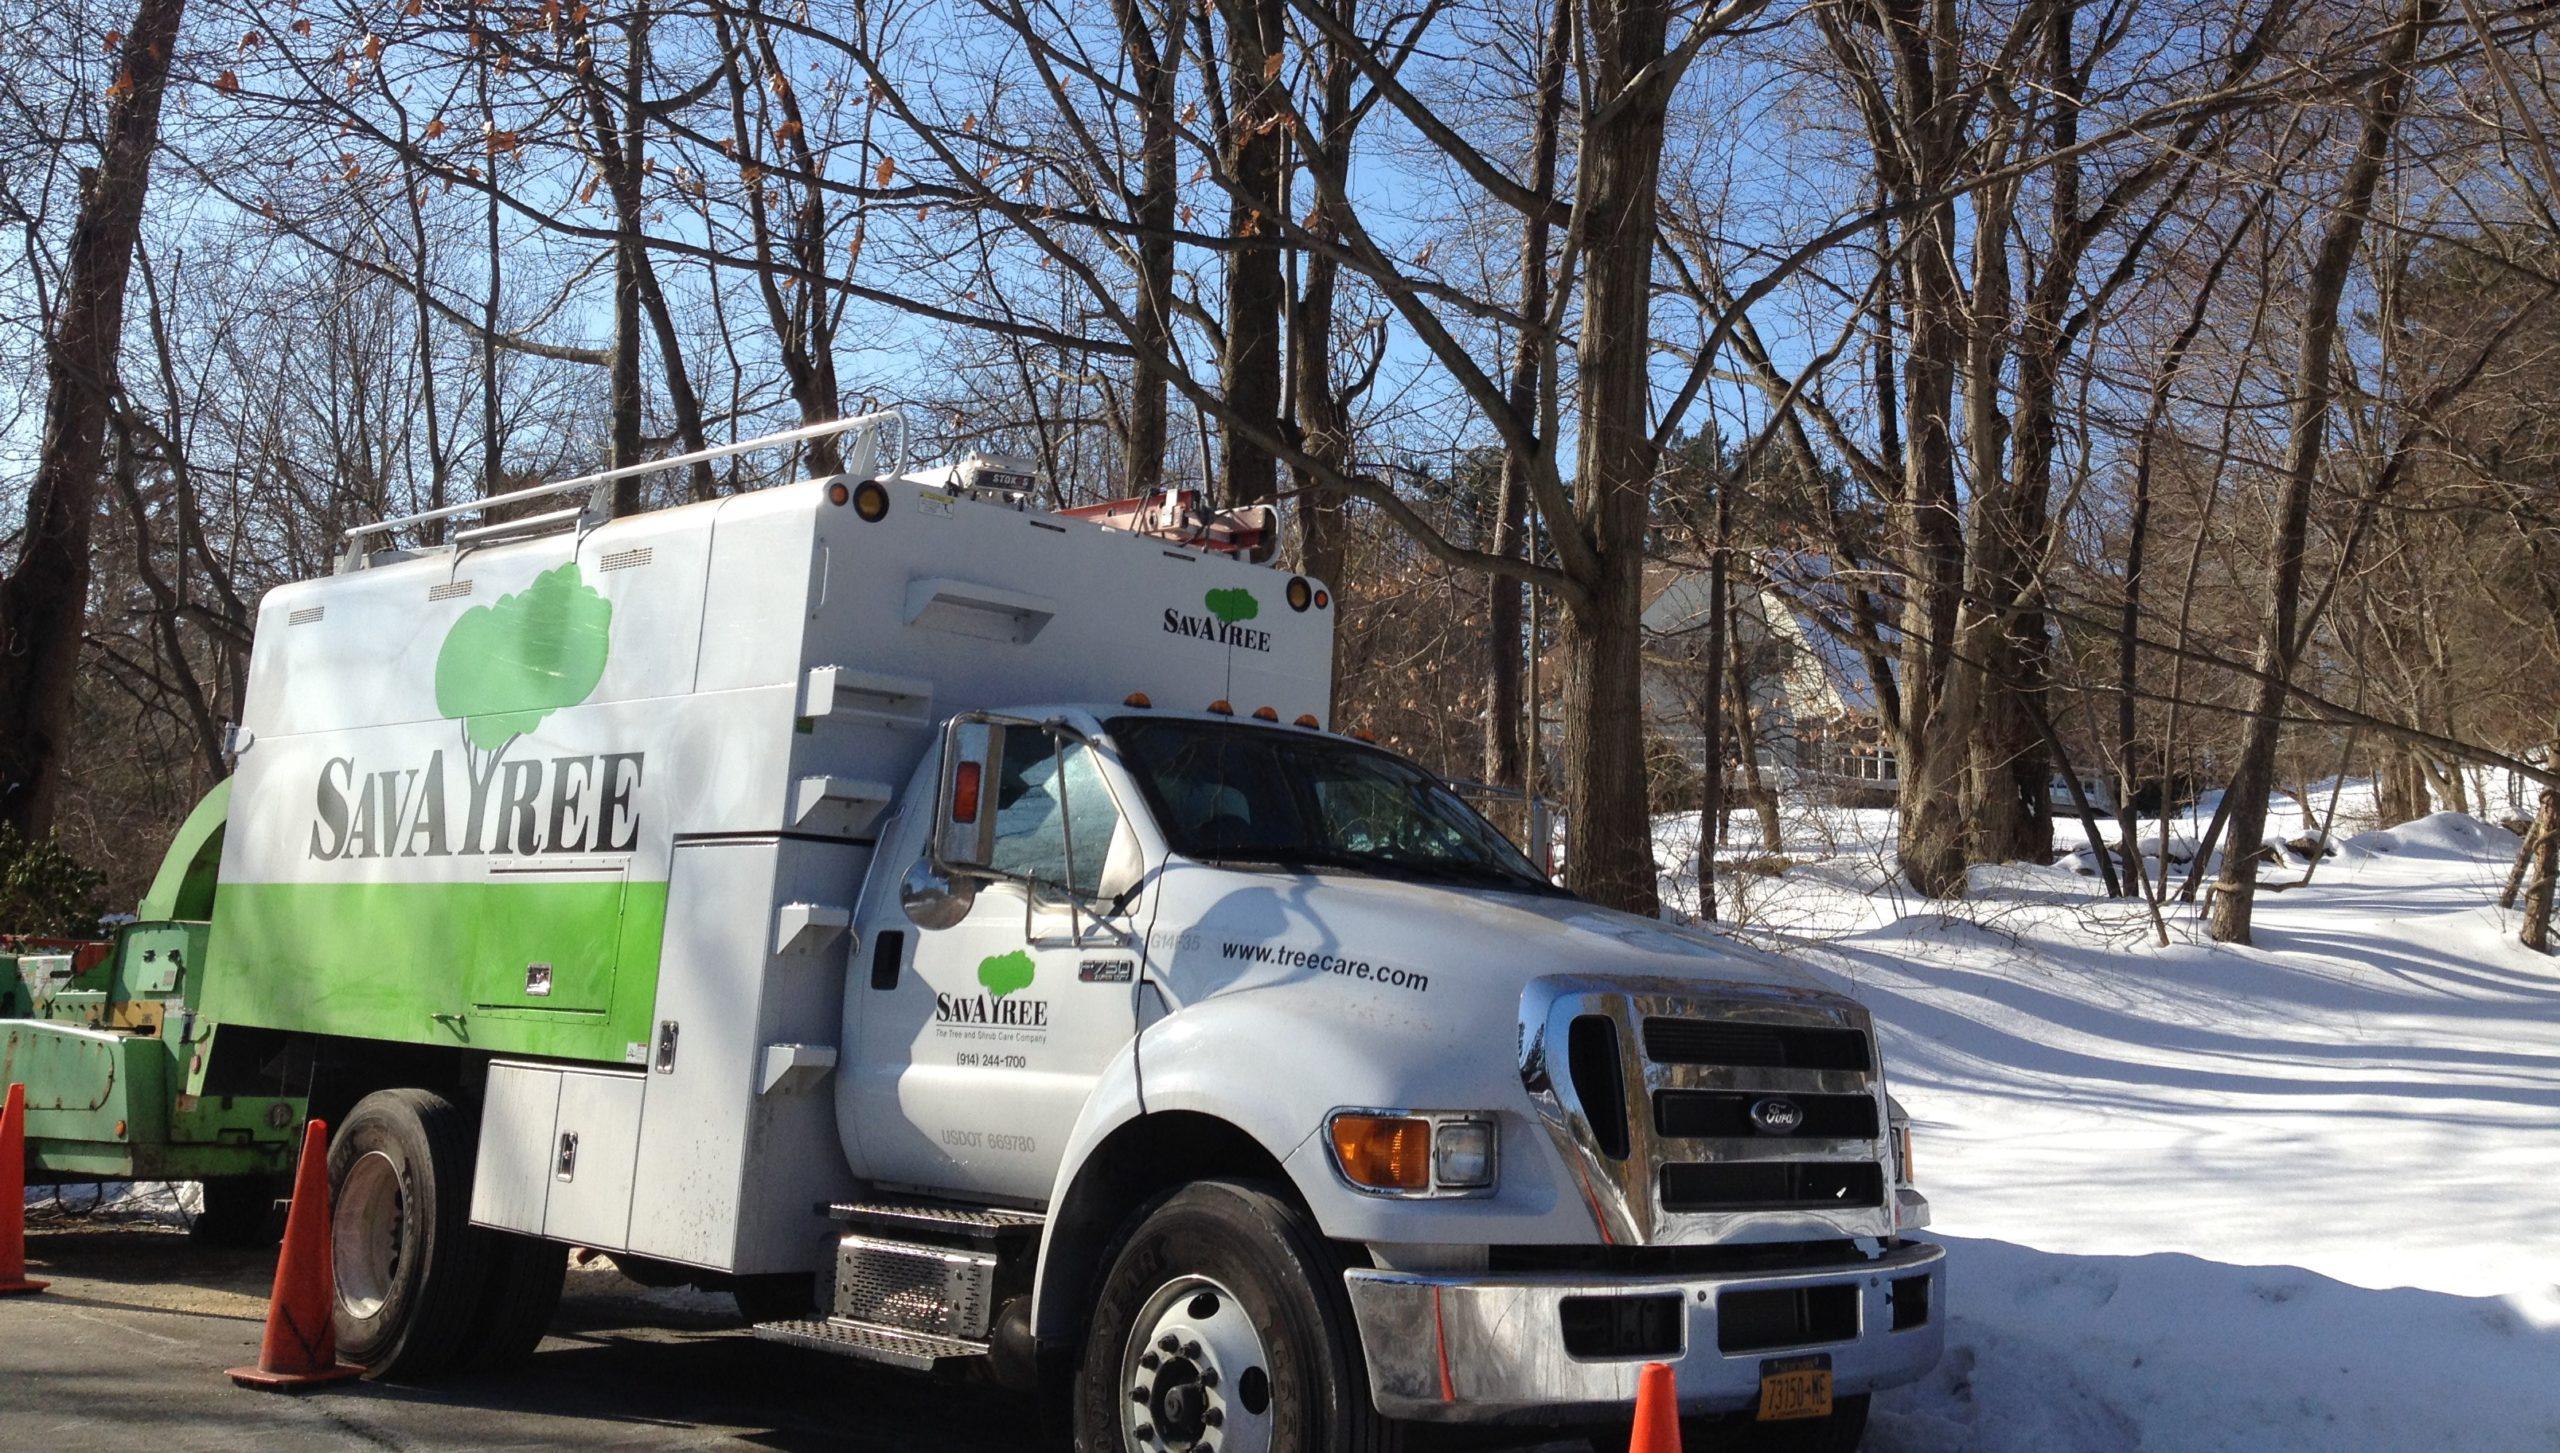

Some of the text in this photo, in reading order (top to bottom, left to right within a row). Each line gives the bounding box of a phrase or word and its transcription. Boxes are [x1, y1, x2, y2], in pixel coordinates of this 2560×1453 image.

[992, 473, 1029, 487] STOKS
[1222, 942, 1429, 992] www.treecare.com
[936, 1028, 1046, 1044] The Tree and Shrub Care Company
[956, 1052, 1026, 1068] (914) 244-1700
[1766, 1103, 1793, 1124] Ford
[942, 1130, 982, 1147] USDOT
